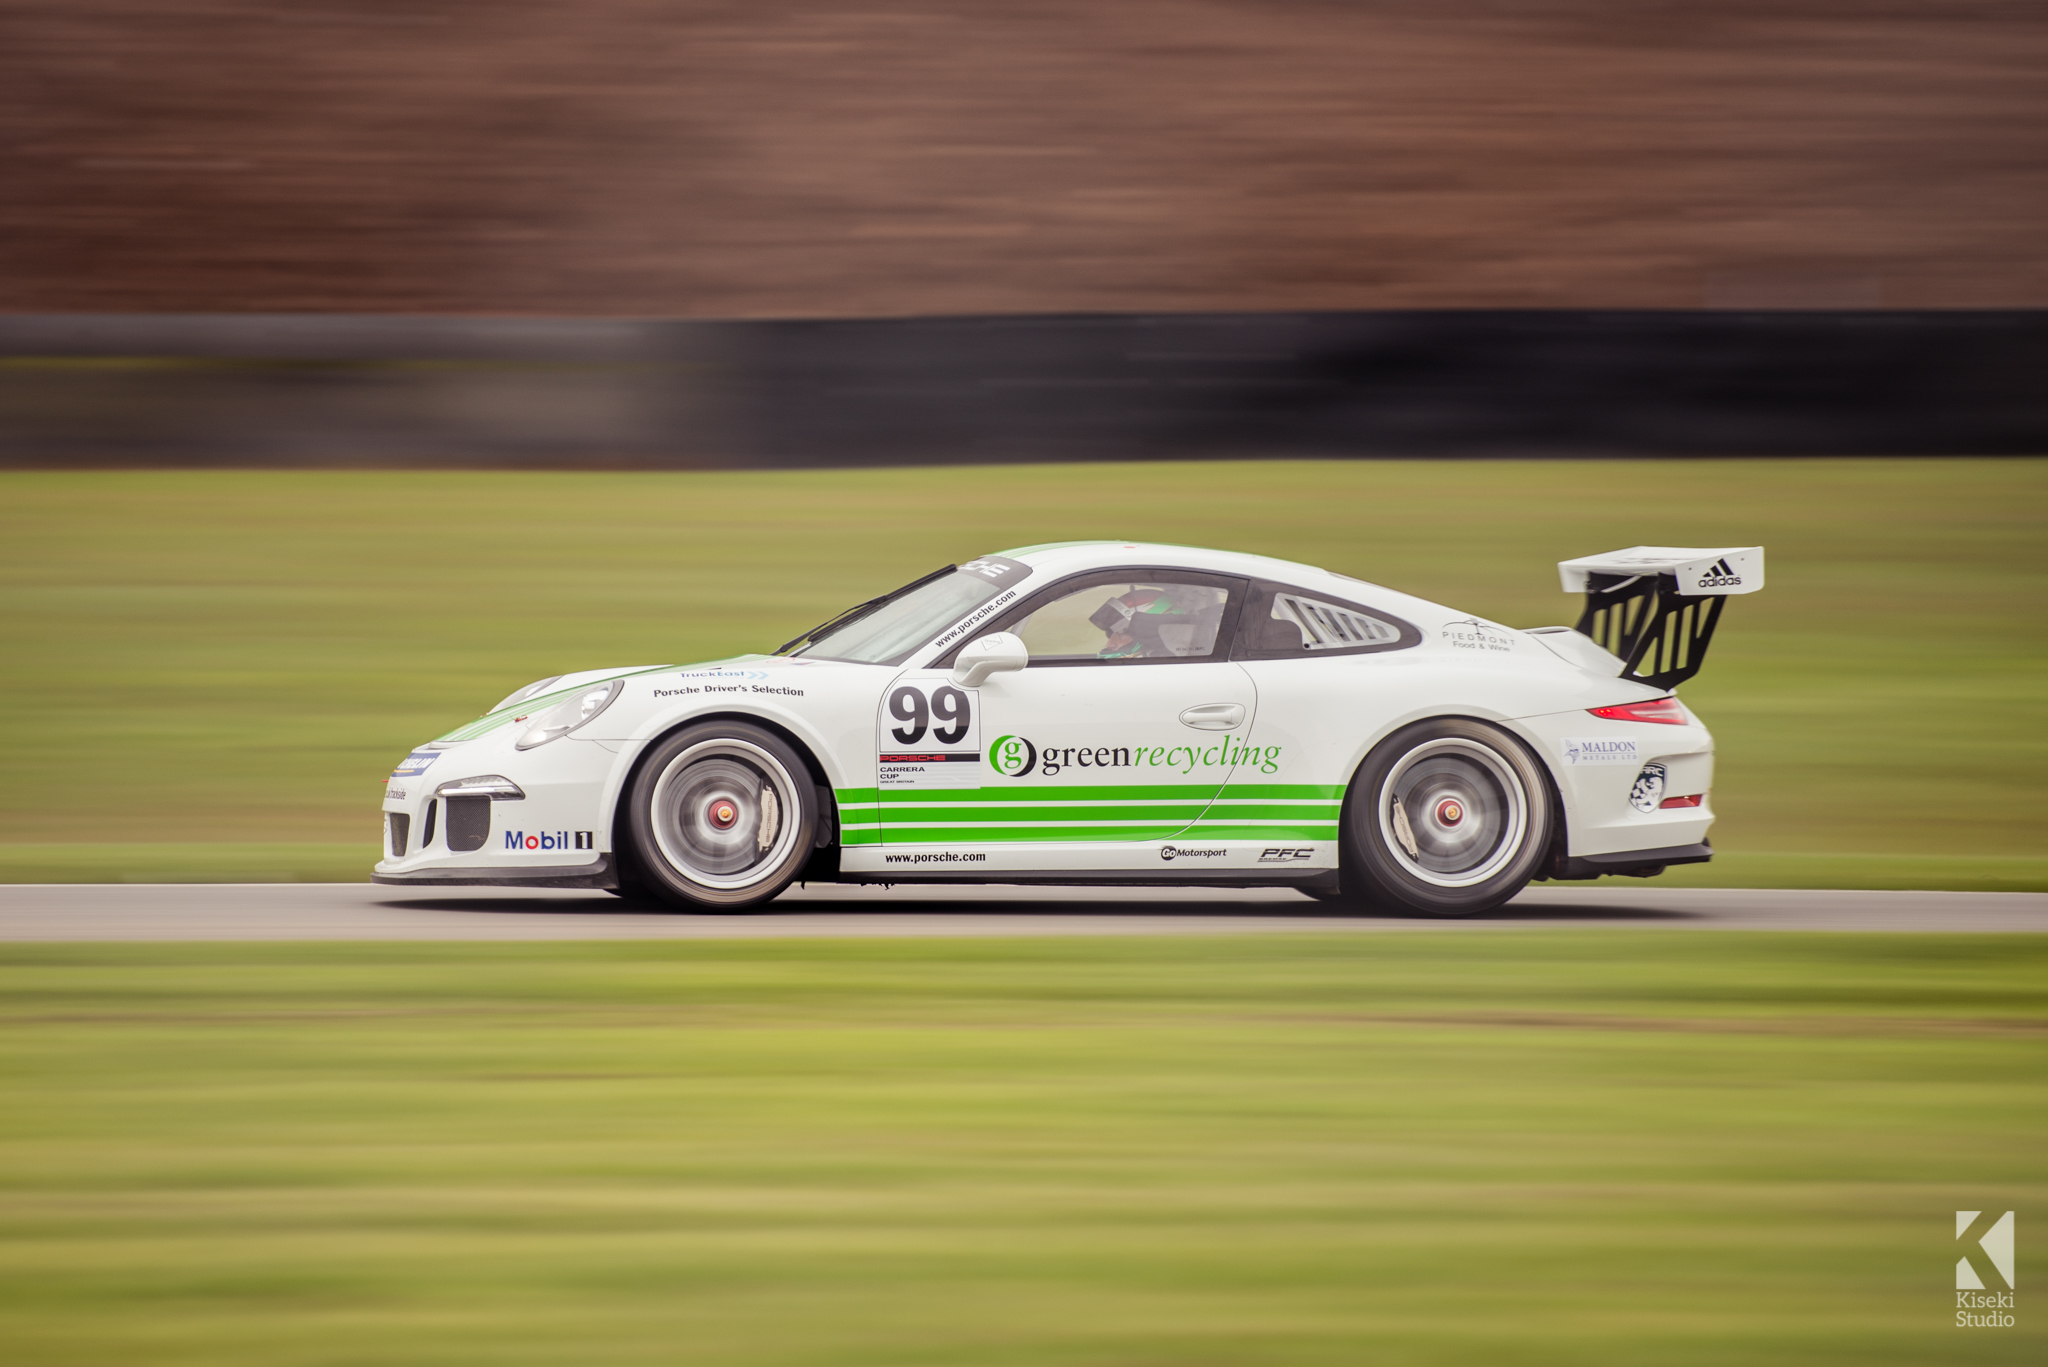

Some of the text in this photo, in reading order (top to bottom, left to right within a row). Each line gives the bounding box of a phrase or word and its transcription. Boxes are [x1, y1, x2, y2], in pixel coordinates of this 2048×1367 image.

[1697, 575, 1742, 588] adidas
[935, 590, 1017, 648] www.porsche.com
[1442, 631, 1516, 646] PIEDMONT
[1452, 640, 1476, 649] Food
[1488, 644, 1511, 652] Wine
[653, 684, 804, 698] Porsche Driver's Selection
[888, 685, 971, 745] 99
[1581, 741, 1636, 753] MALDON
[879, 754, 946, 762] PORSCHE
[504, 830, 590, 850] Mobil 1
[885, 851, 986, 865] www.porsche.com
[1260, 848, 1315, 858] PFC
